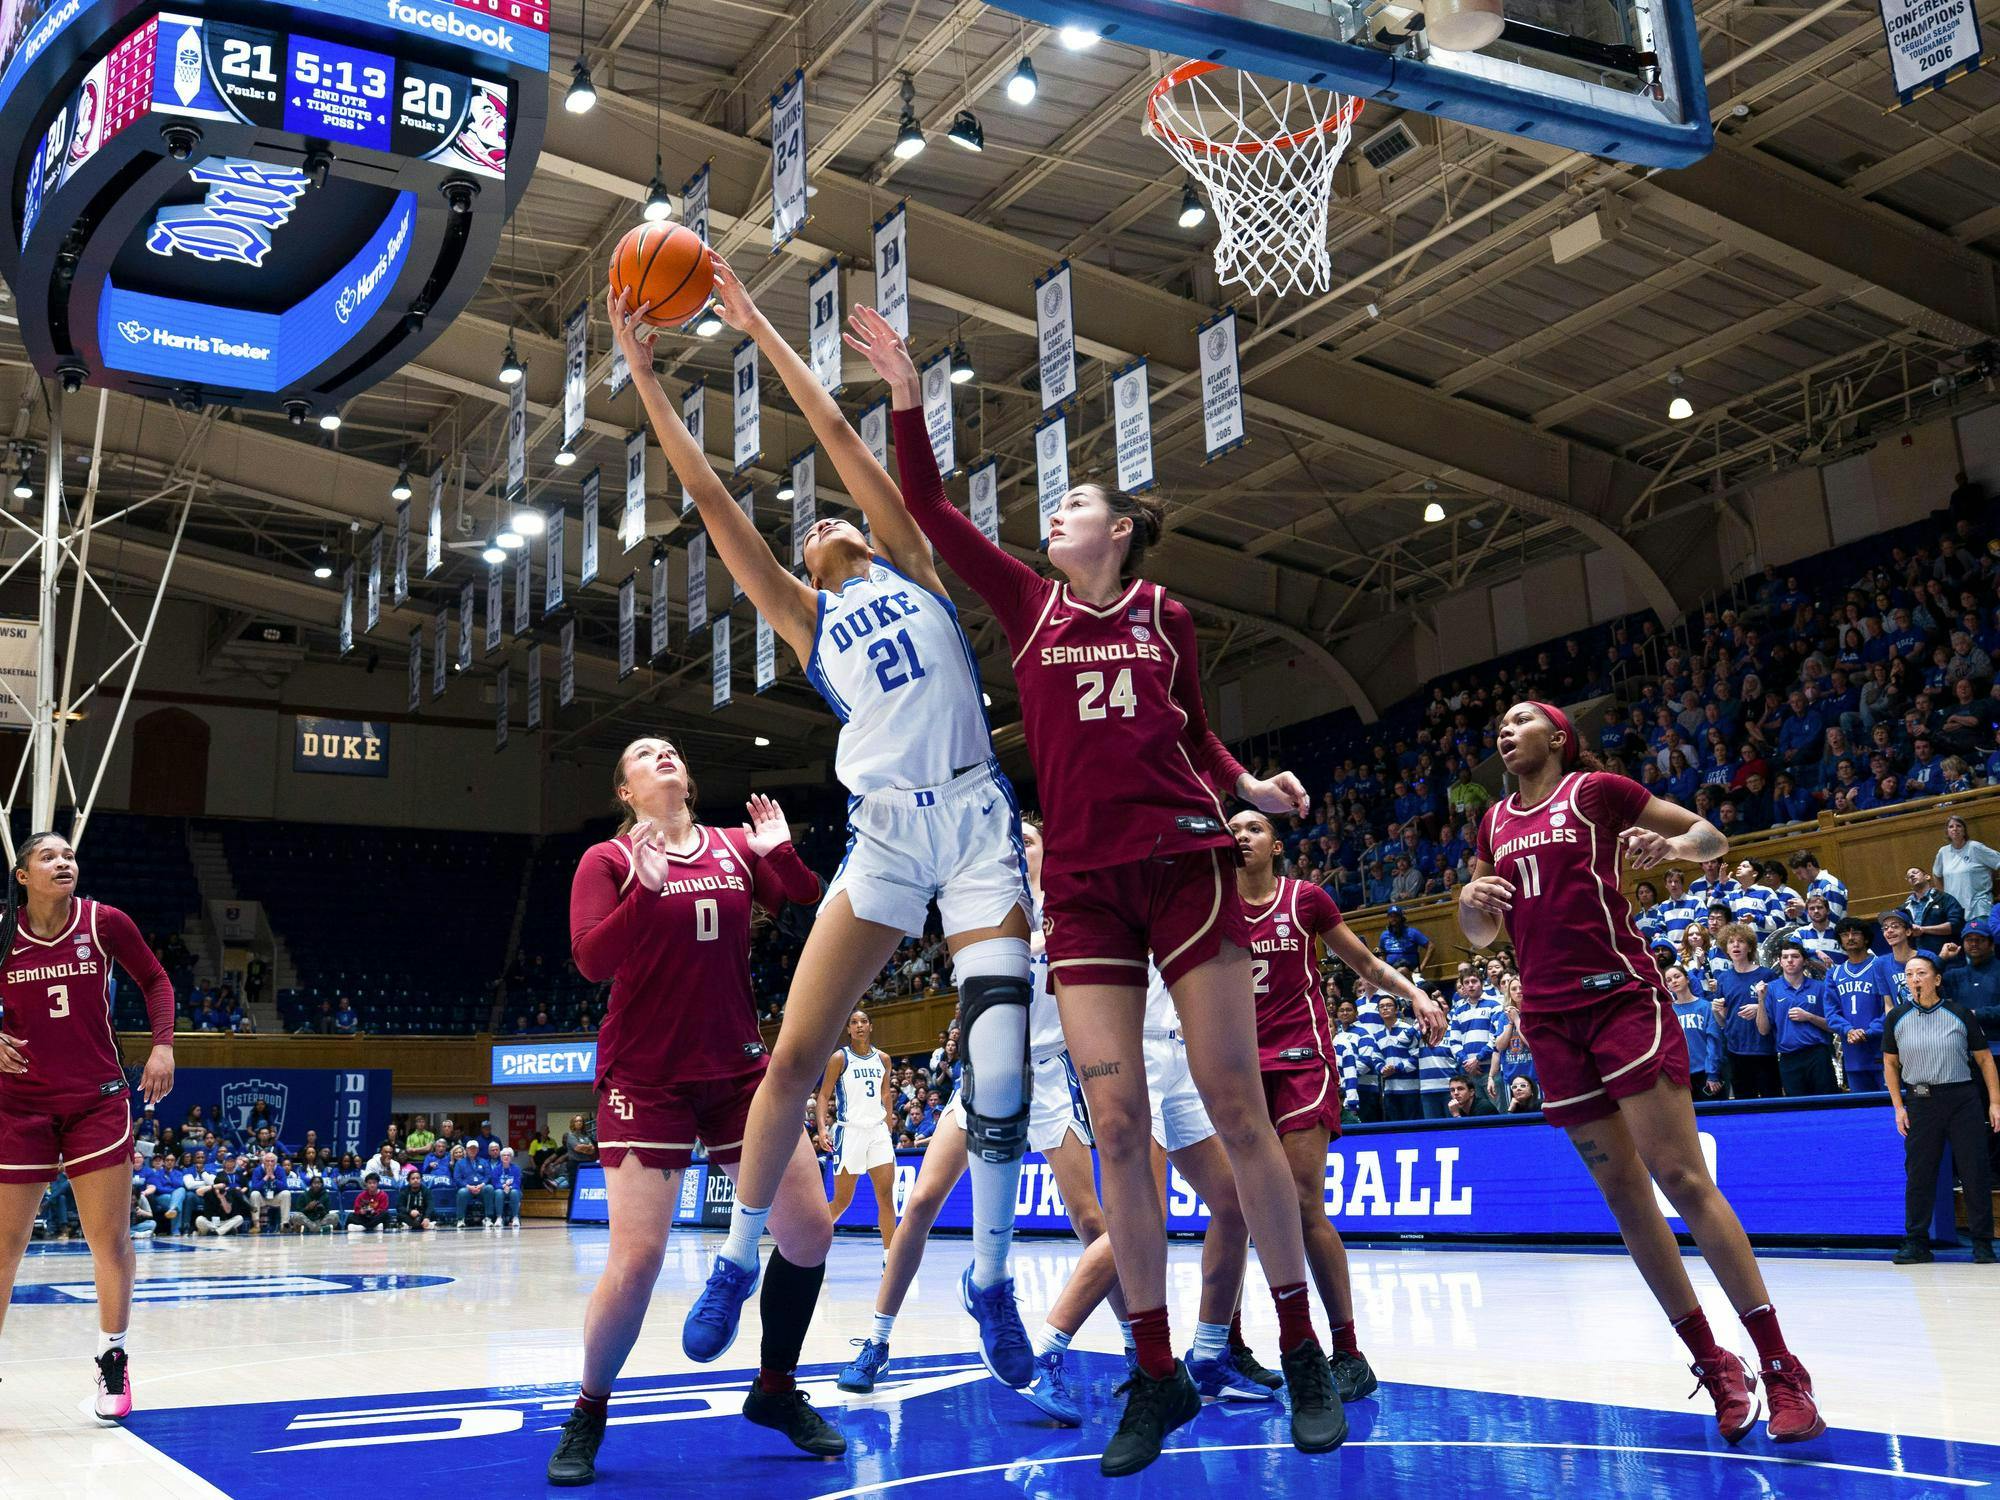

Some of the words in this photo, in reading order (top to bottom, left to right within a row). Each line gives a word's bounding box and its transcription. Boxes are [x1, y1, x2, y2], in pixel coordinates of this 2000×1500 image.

[25, 0, 80, 64] facebook
[387, 1, 514, 53] facebook
[1893, 1, 1965, 47] CHAMPIONS
[1901, 32, 1932, 54] REGULAR
[1932, 18, 1960, 38] SEASON
[1909, 31, 1956, 60] TOURNAMENT
[1919, 45, 1953, 72] 2006
[221, 38, 277, 83] 21
[295, 51, 387, 99] 5:13
[226, 83, 265, 101] Fouls:
[268, 91, 277, 101] 0
[312, 88, 339, 103] 2ND
[341, 94, 367, 109] QTR
[402, 76, 452, 120] 20
[291, 96, 301, 108] 4
[307, 98, 372, 123] TIMEOUTS
[377, 114, 386, 125] 4
[322, 113, 355, 130] POSS
[400, 114, 435, 132] Fouls:
[437, 121, 445, 134] 3
[45, 107, 67, 171] 20
[776, 127, 799, 177] 24
[355, 254, 388, 306] Harris
[387, 209, 411, 260] Teeter
[1043, 320, 1066, 341] ATLANTIC
[1047, 333, 1063, 351] COAST
[152, 328, 209, 354] Harris
[210, 338, 271, 361] Teeter
[1040, 339, 1072, 367] CONFERENCE
[1042, 352, 1071, 378] CHAMPIONS
[1207, 365, 1232, 386] ATLANTIC
[1204, 384, 1239, 411] CONFERENCE
[1211, 378, 1230, 395] COAST
[1120, 412, 1144, 430] ATLANTIC
[1205, 397, 1238, 421] CHAMPIONS
[1118, 431, 1150, 453] CONFERENCE
[1124, 424, 1140, 439] COAST
[1215, 426, 1232, 441] 2005
[1119, 442, 1149, 464] CHAMPIONS
[829, 591, 920, 654] DUKE
[867, 628, 926, 693] 21
[1041, 643, 1162, 666] SEMINOLES
[1076, 668, 1138, 722] 24
[303, 732, 381, 761] DUKE
[1514, 855, 1541, 899] 11
[695, 898, 719, 941] 0
[7, 961, 98, 985] SEMINOLES
[47, 985, 70, 1018] 3
[1837, 980, 1873, 996] DUKE
[1850, 995, 1857, 1015] 1
[502, 1052, 593, 1075] DIRECTV
[853, 1069, 882, 1079] DUKE
[227, 1094, 282, 1109] SISTERHOOD
[865, 1080, 875, 1098] 3
[608, 1088, 634, 1120] FSU
